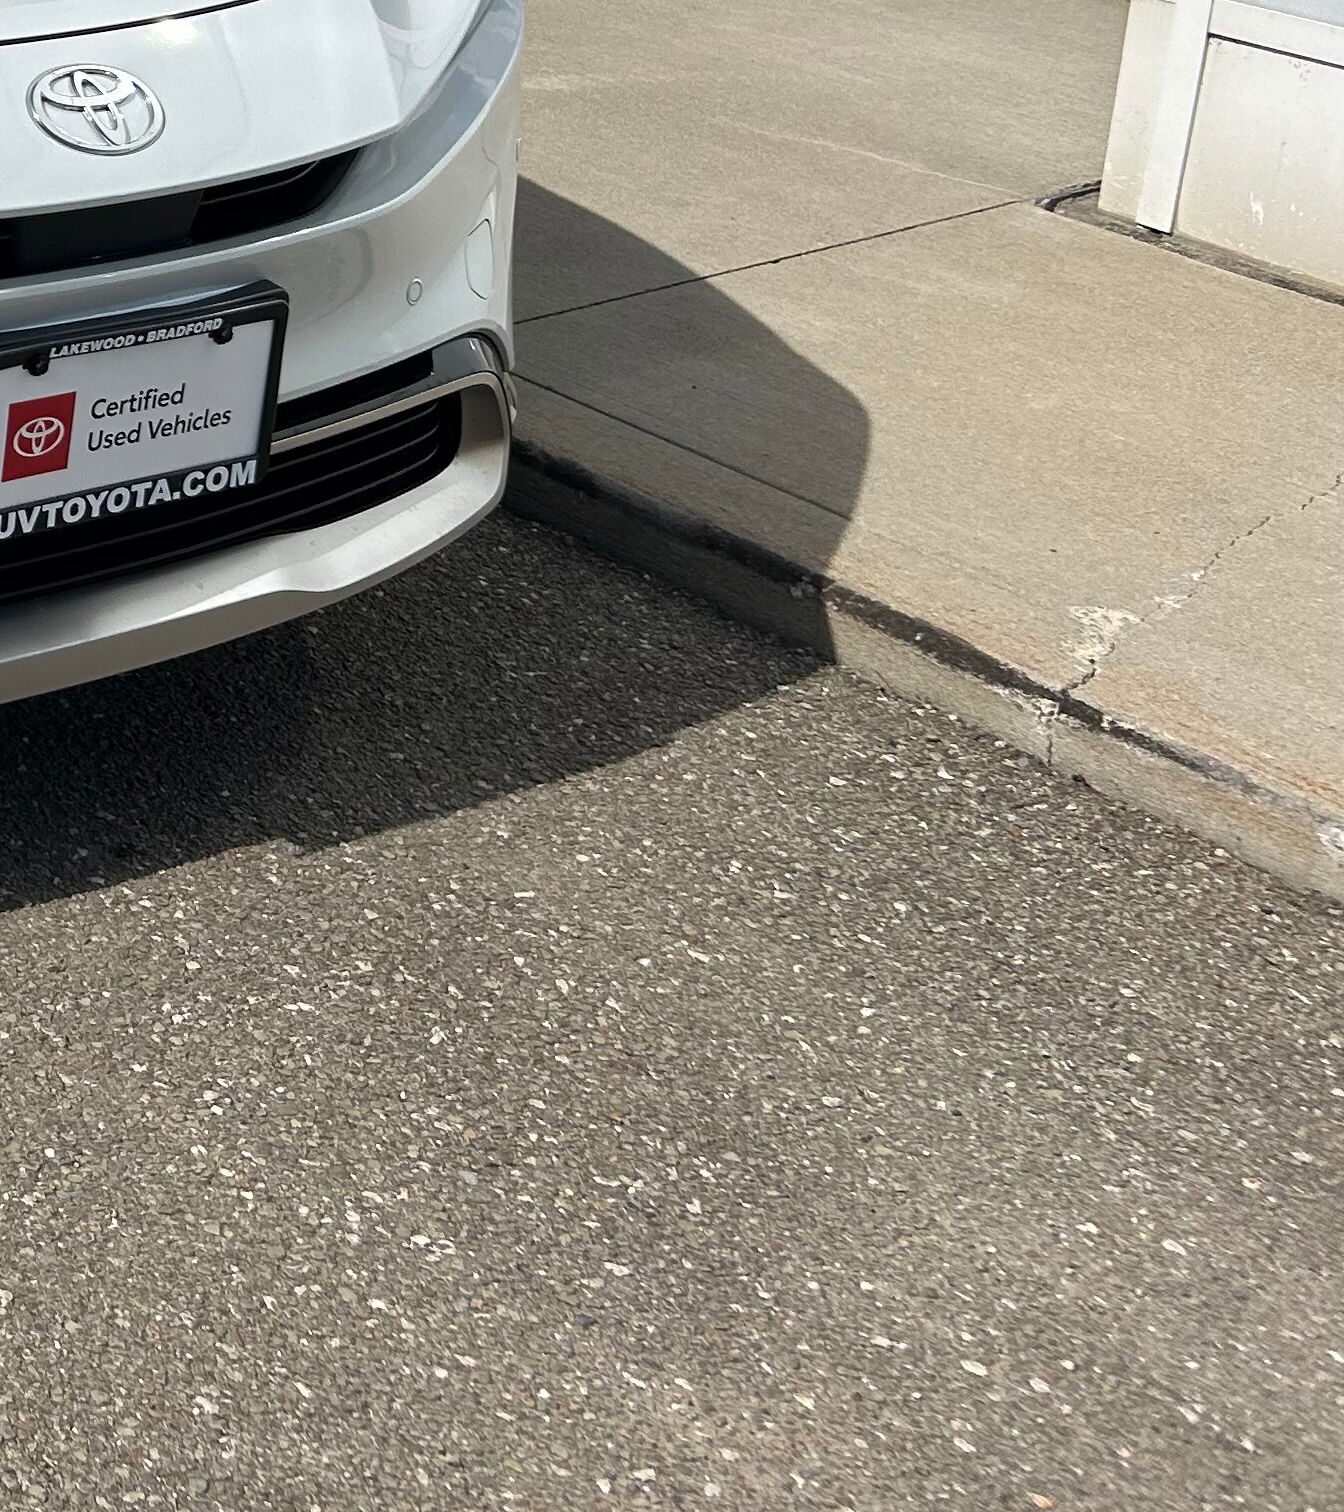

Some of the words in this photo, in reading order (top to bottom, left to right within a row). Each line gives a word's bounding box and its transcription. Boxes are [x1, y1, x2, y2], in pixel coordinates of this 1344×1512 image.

[49, 334, 136, 359] LAKEWOOD
[146, 318, 223, 343] BRADFORD
[90, 383, 186, 420] Certified
[87, 421, 140, 452] Used
[148, 408, 232, 440] Vehicles
